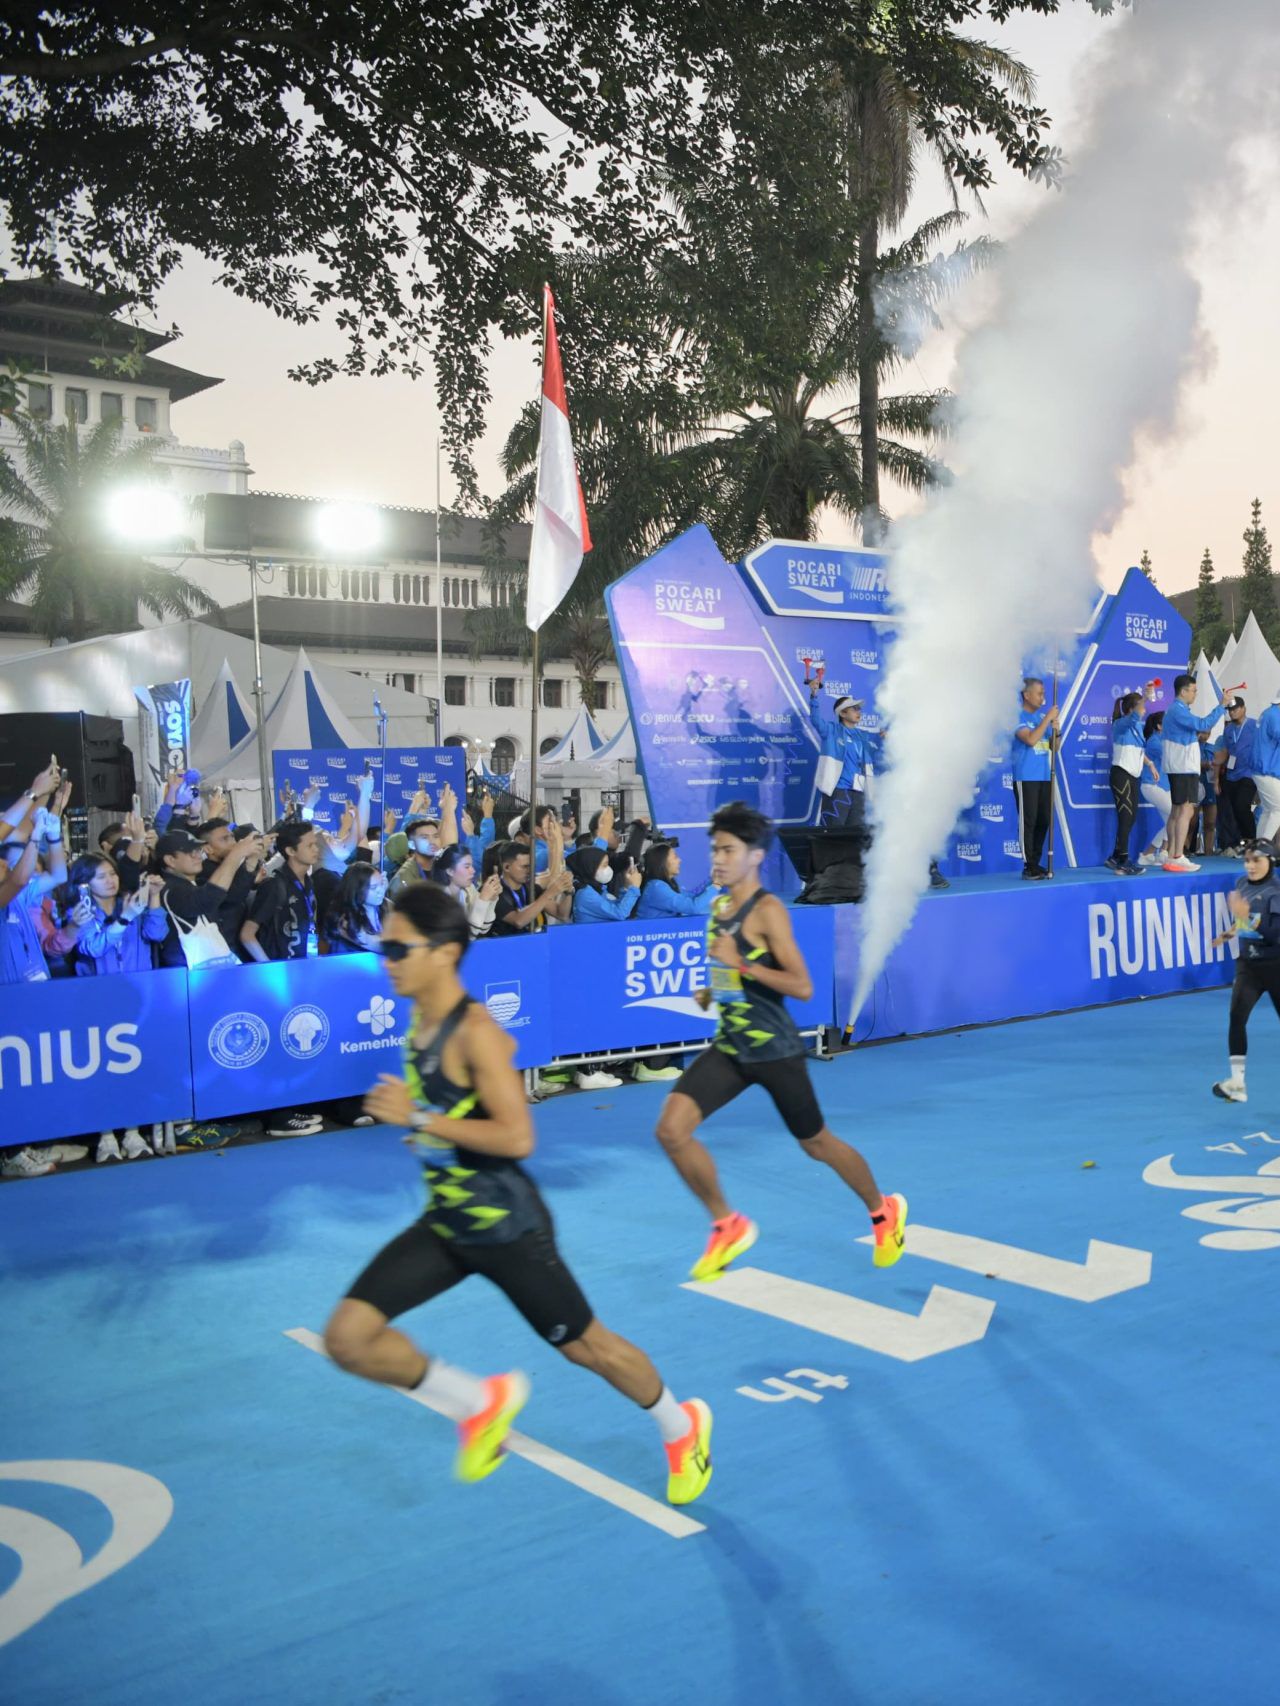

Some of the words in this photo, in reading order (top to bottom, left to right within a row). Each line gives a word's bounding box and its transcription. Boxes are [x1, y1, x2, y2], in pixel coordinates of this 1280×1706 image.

[787, 559, 841, 577] POCARI
[788, 572, 837, 588] SWEAT
[656, 584, 721, 601] POCARI
[849, 592, 889, 602] INDONES
[656, 598, 716, 613] SWEAT
[1125, 616, 1167, 631] POCARI
[1125, 627, 1163, 640] SWEAT
[646, 932, 676, 941] SUPPLY
[1088, 891, 1241, 979] RUNNIN
[626, 940, 710, 971] POC
[625, 966, 706, 997] SWE
[340, 1034, 409, 1054] Kemenke
